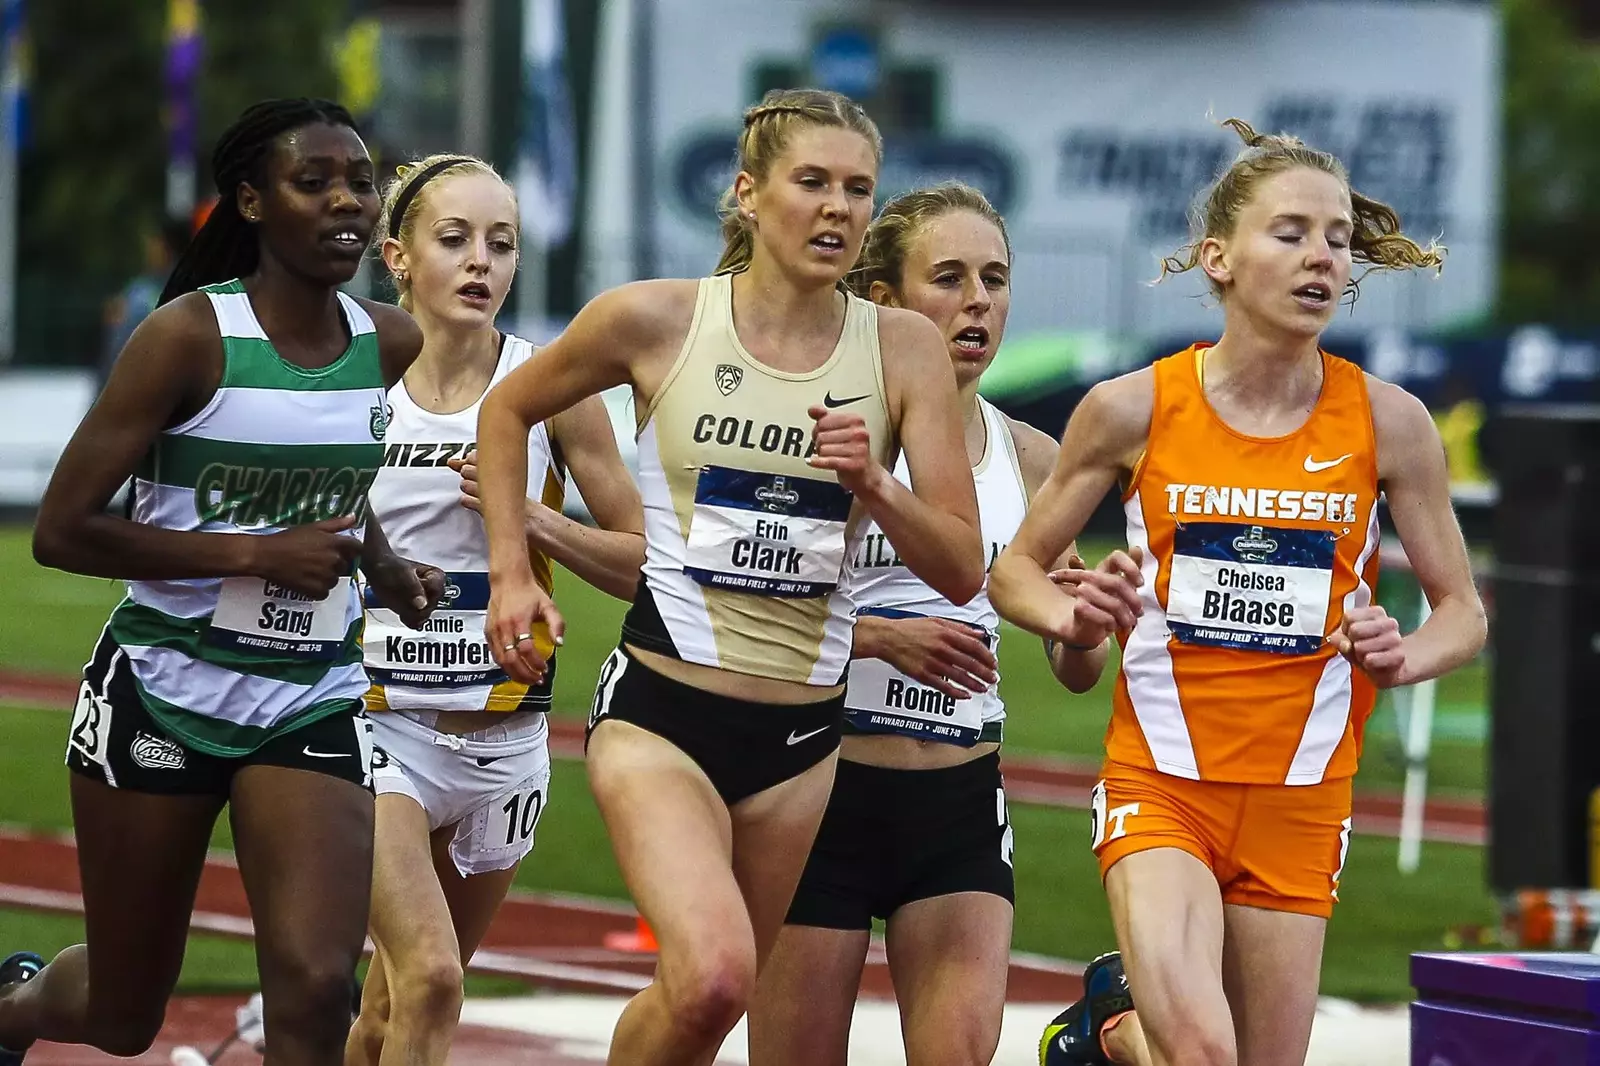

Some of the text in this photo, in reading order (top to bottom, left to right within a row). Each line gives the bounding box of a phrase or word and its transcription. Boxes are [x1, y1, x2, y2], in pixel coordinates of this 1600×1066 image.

[720, 378, 733, 390] 12
[1165, 483, 1357, 523] TENNESSEE
[755, 519, 788, 541] Erin
[731, 539, 804, 575] Clark
[712, 574, 746, 587] HAYWARD
[747, 579, 767, 589] FIELD
[776, 582, 795, 592] JUNE
[1217, 568, 1285, 592] Chelsea
[1202, 590, 1295, 627] Blaase
[257, 602, 314, 637] Sang
[416, 615, 464, 633] amie
[237, 635, 270, 648] HAYWARD
[270, 641, 289, 651] FIELD
[296, 643, 312, 652] JUNE
[1194, 629, 1230, 641] HAYWARD
[1231, 633, 1251, 643] FIELD
[1262, 637, 1282, 647] JUNE
[391, 672, 424, 683] HAYWARD
[424, 673, 444, 683] FIELD
[454, 673, 473, 682] JUNE
[885, 678, 956, 717] Rome
[870, 715, 905, 728] HAYWARD
[905, 720, 924, 731] FIELD
[932, 725, 949, 735] JUNE
[139, 748, 182, 764] 49ERS
[502, 790, 542, 845] 10
